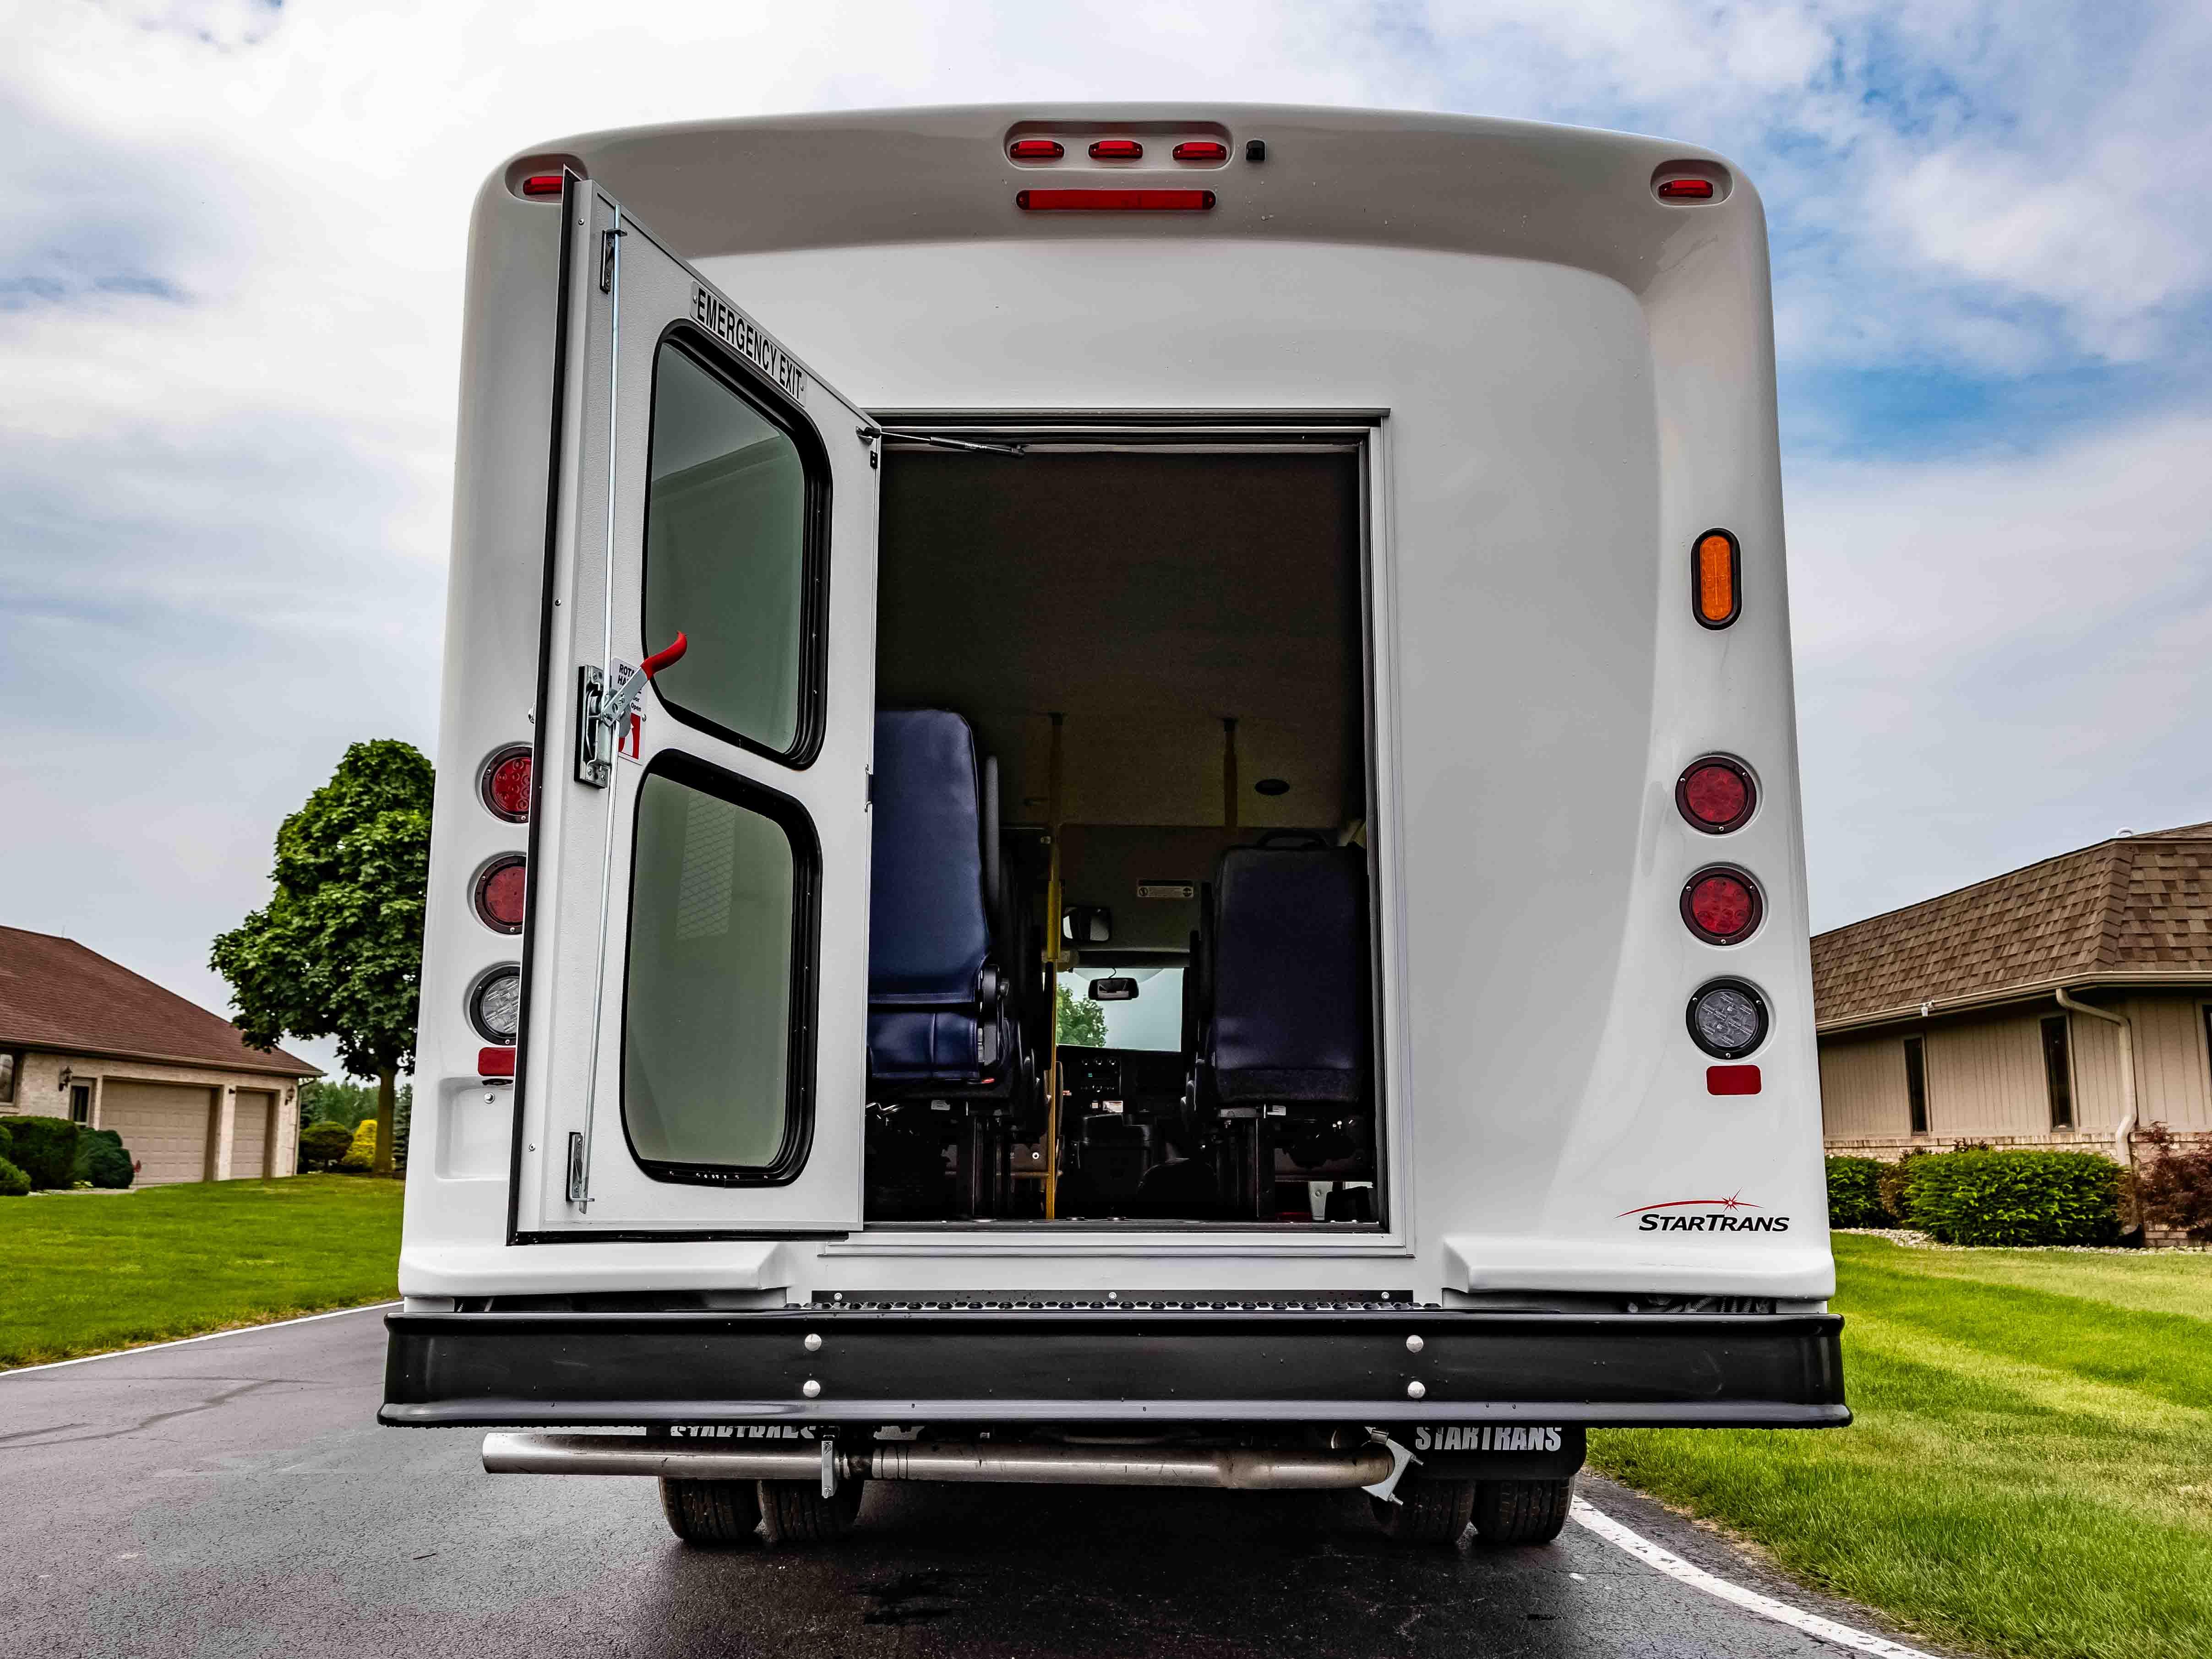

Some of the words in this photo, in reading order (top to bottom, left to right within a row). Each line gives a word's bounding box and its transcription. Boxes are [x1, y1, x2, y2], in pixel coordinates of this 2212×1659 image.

[697, 287, 777, 376] EMERGENCY
[779, 354, 802, 399] EXIT
[631, 702, 642, 712] Open
